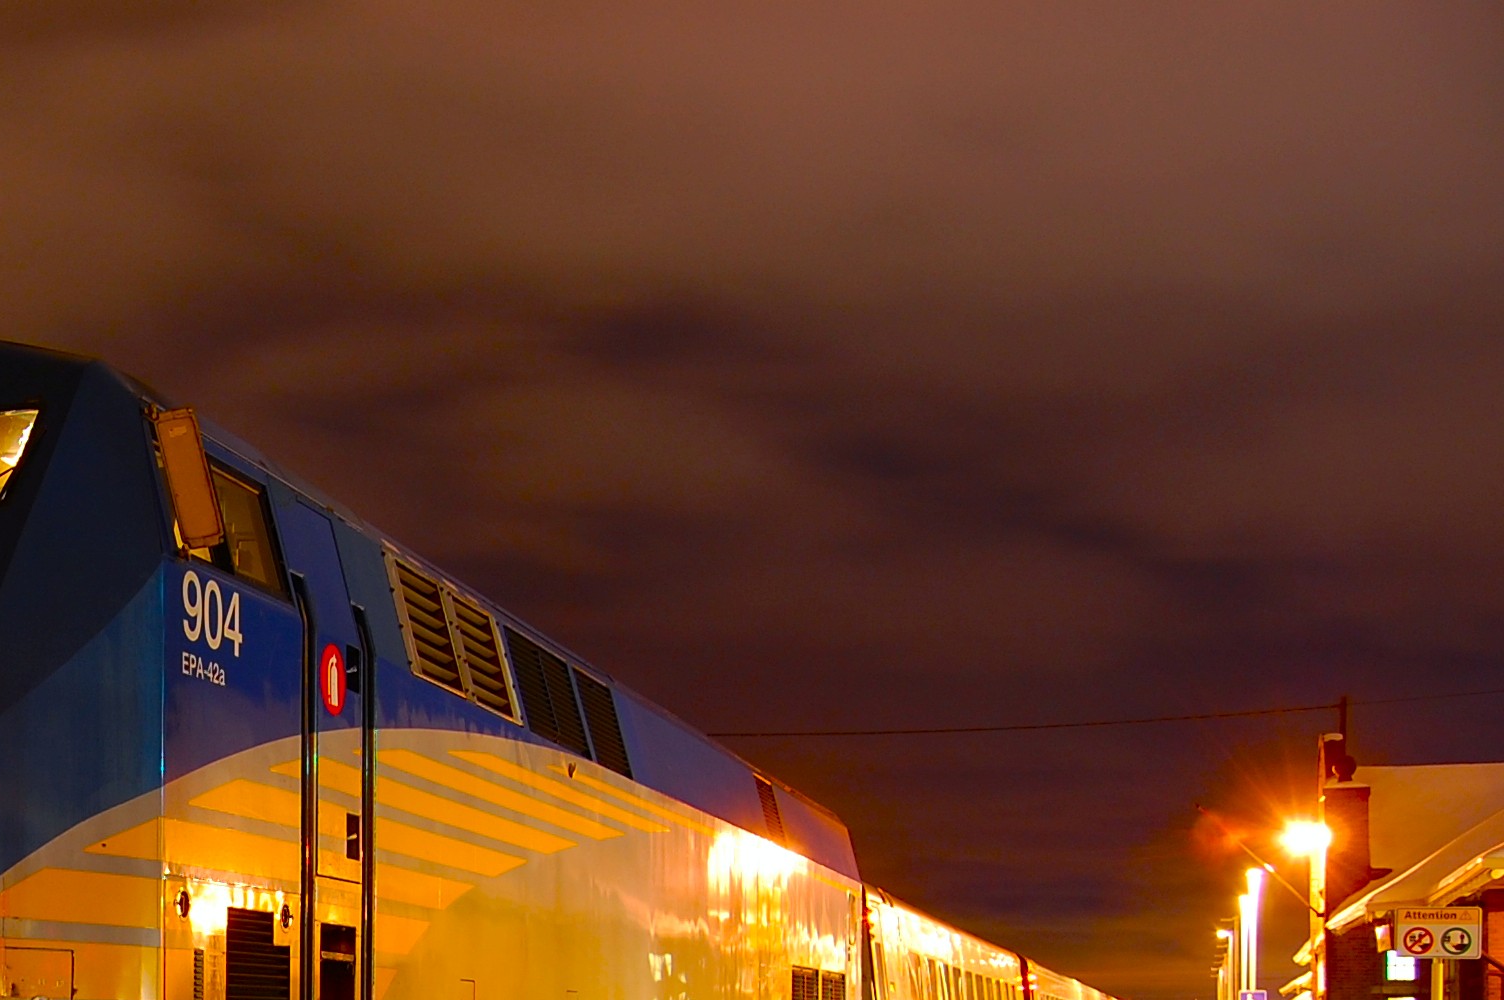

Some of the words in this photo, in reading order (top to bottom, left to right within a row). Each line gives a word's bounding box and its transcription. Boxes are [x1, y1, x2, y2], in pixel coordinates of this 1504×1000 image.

[182, 570, 243, 658] 904
[182, 651, 226, 686] EPA-42a
[1404, 911, 1457, 920] Attention
